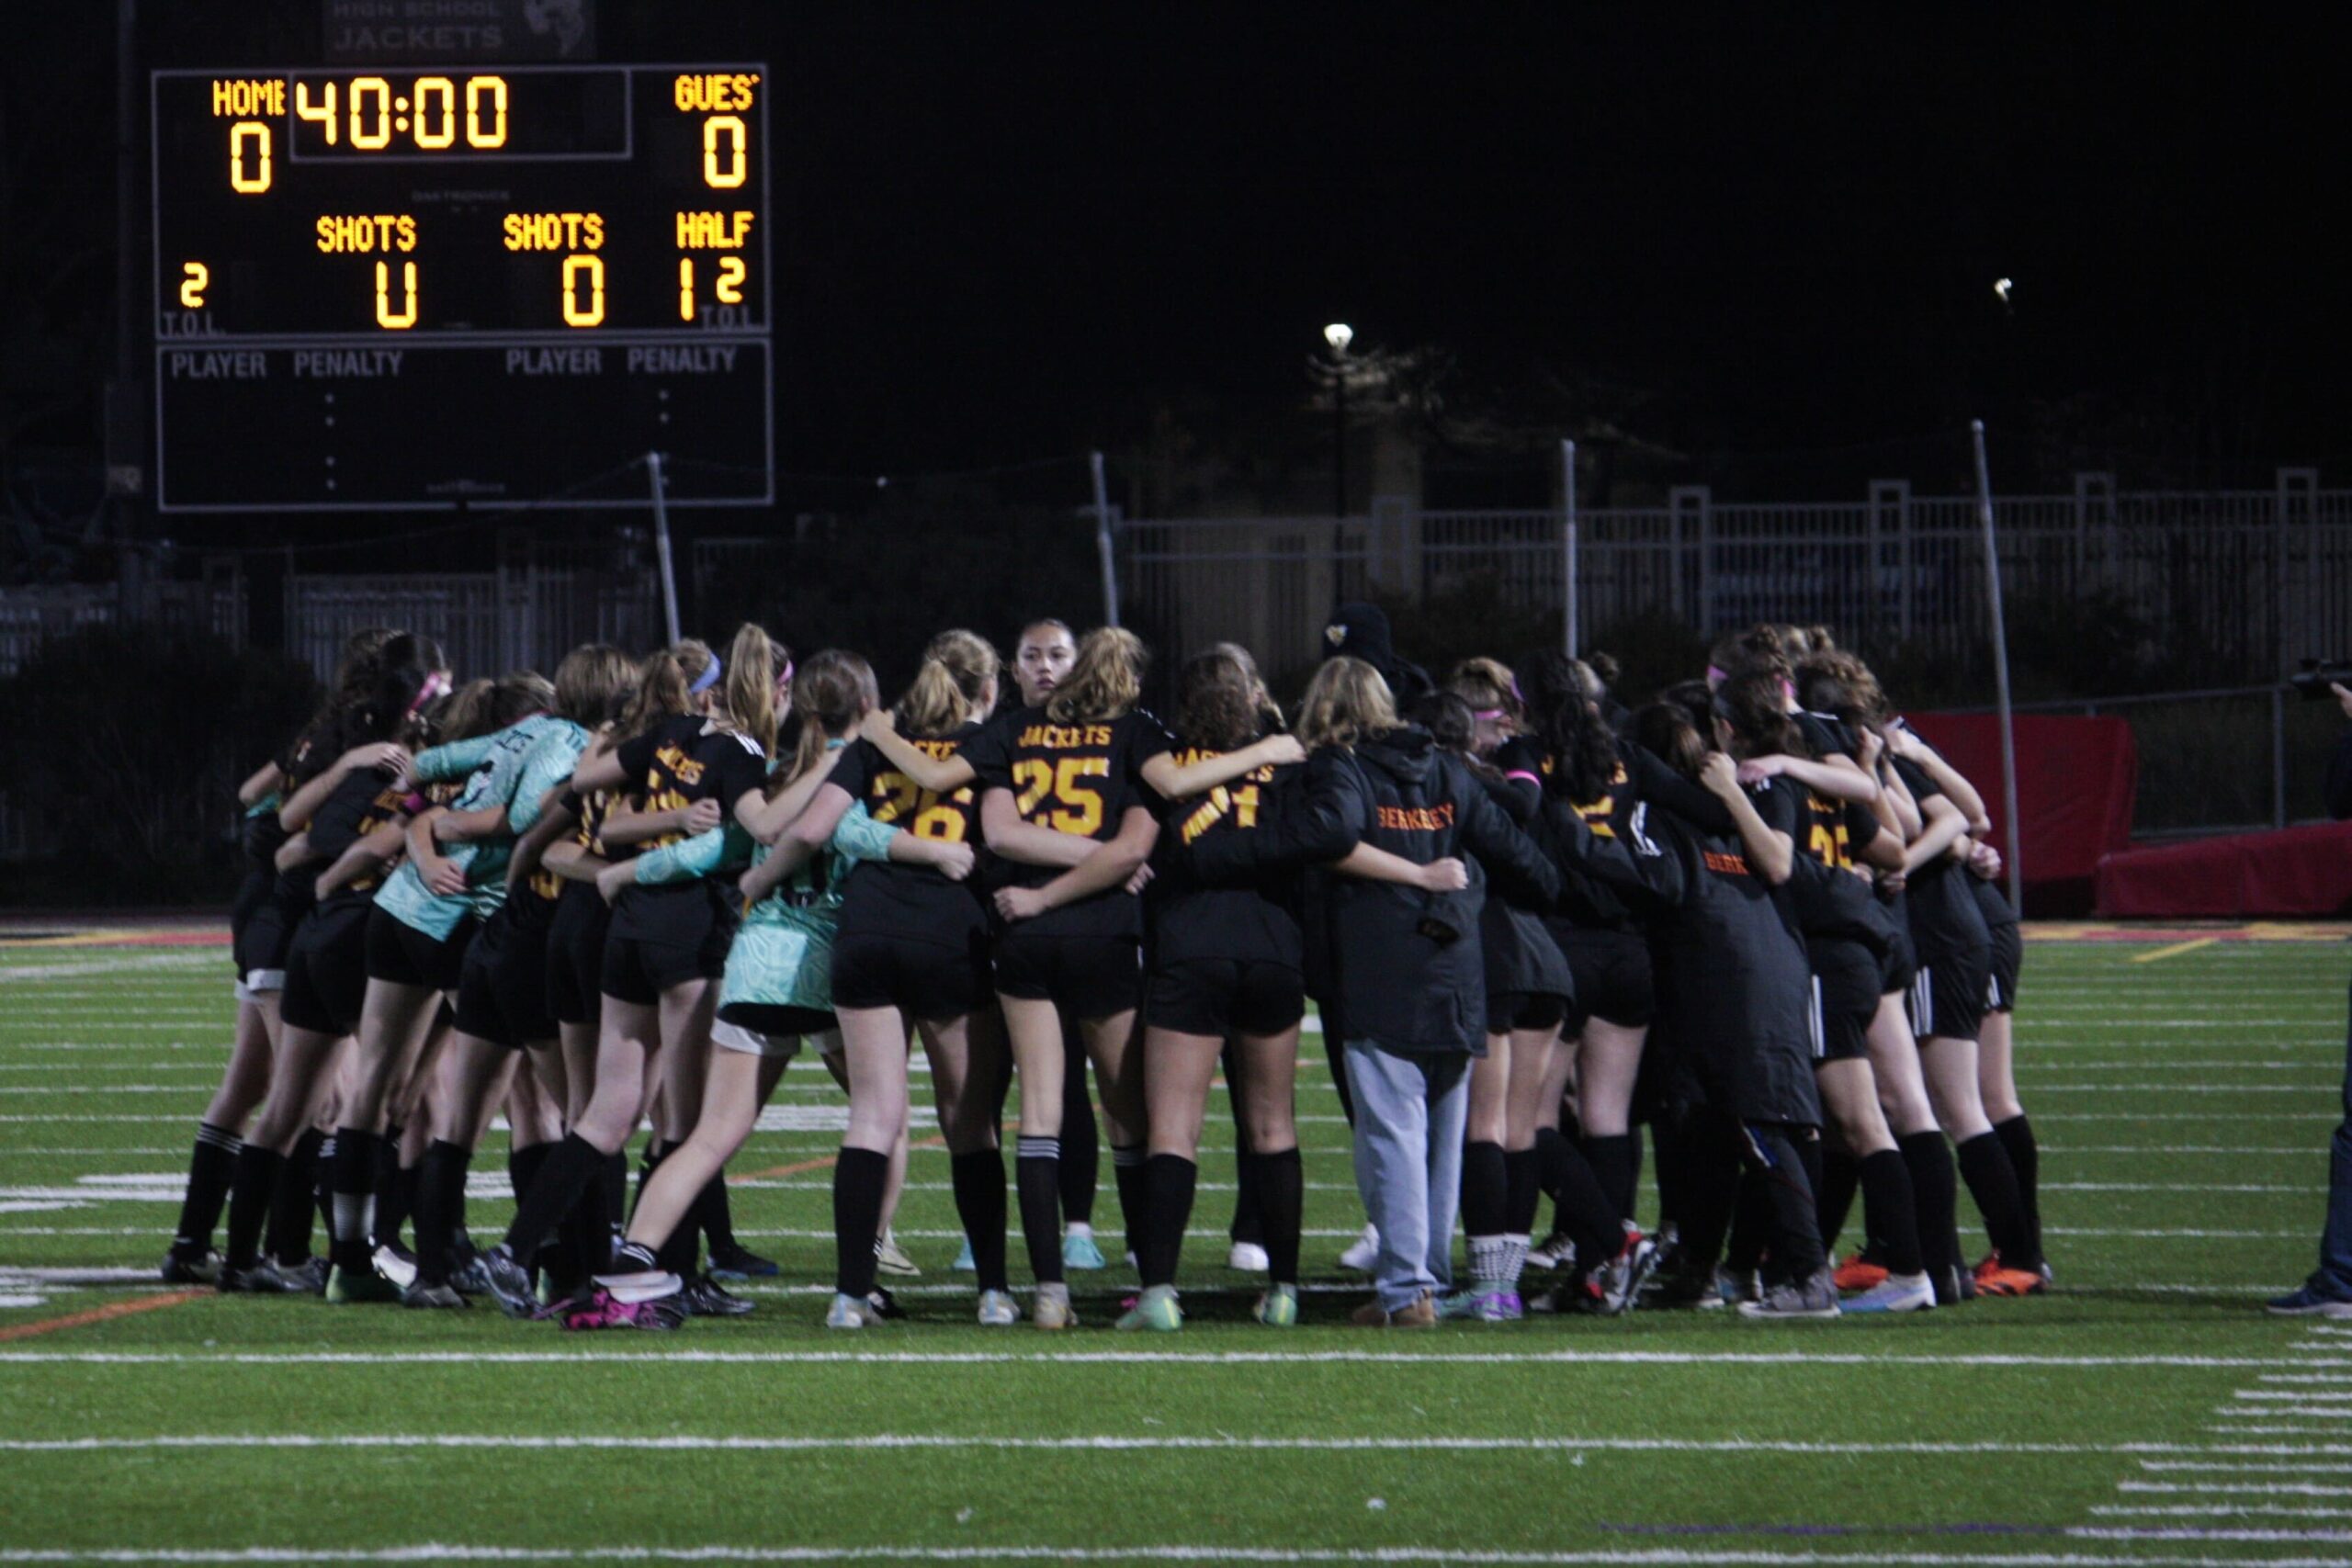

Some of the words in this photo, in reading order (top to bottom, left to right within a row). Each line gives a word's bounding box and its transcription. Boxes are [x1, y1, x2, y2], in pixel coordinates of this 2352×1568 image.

[404, 0, 502, 16] SCHOOL
[334, 25, 503, 50] JACKETS
[212, 79, 287, 117] HOME
[675, 74, 761, 111] GUES
[296, 76, 507, 150] 40:00
[231, 121, 271, 193] 0
[704, 116, 746, 188] 0
[317, 215, 417, 253] SHOTS
[503, 213, 605, 251] SHOTS
[676, 211, 754, 249] HALF
[181, 263, 209, 308] 2
[562, 254, 605, 327] 0
[172, 352, 267, 378] PLAYER
[293, 351, 403, 378] PENALTY
[506, 348, 602, 375] PLAYER
[627, 346, 737, 373] PENALTY
[1012, 756, 1110, 838] 25
[1703, 850, 1750, 876] BERK
